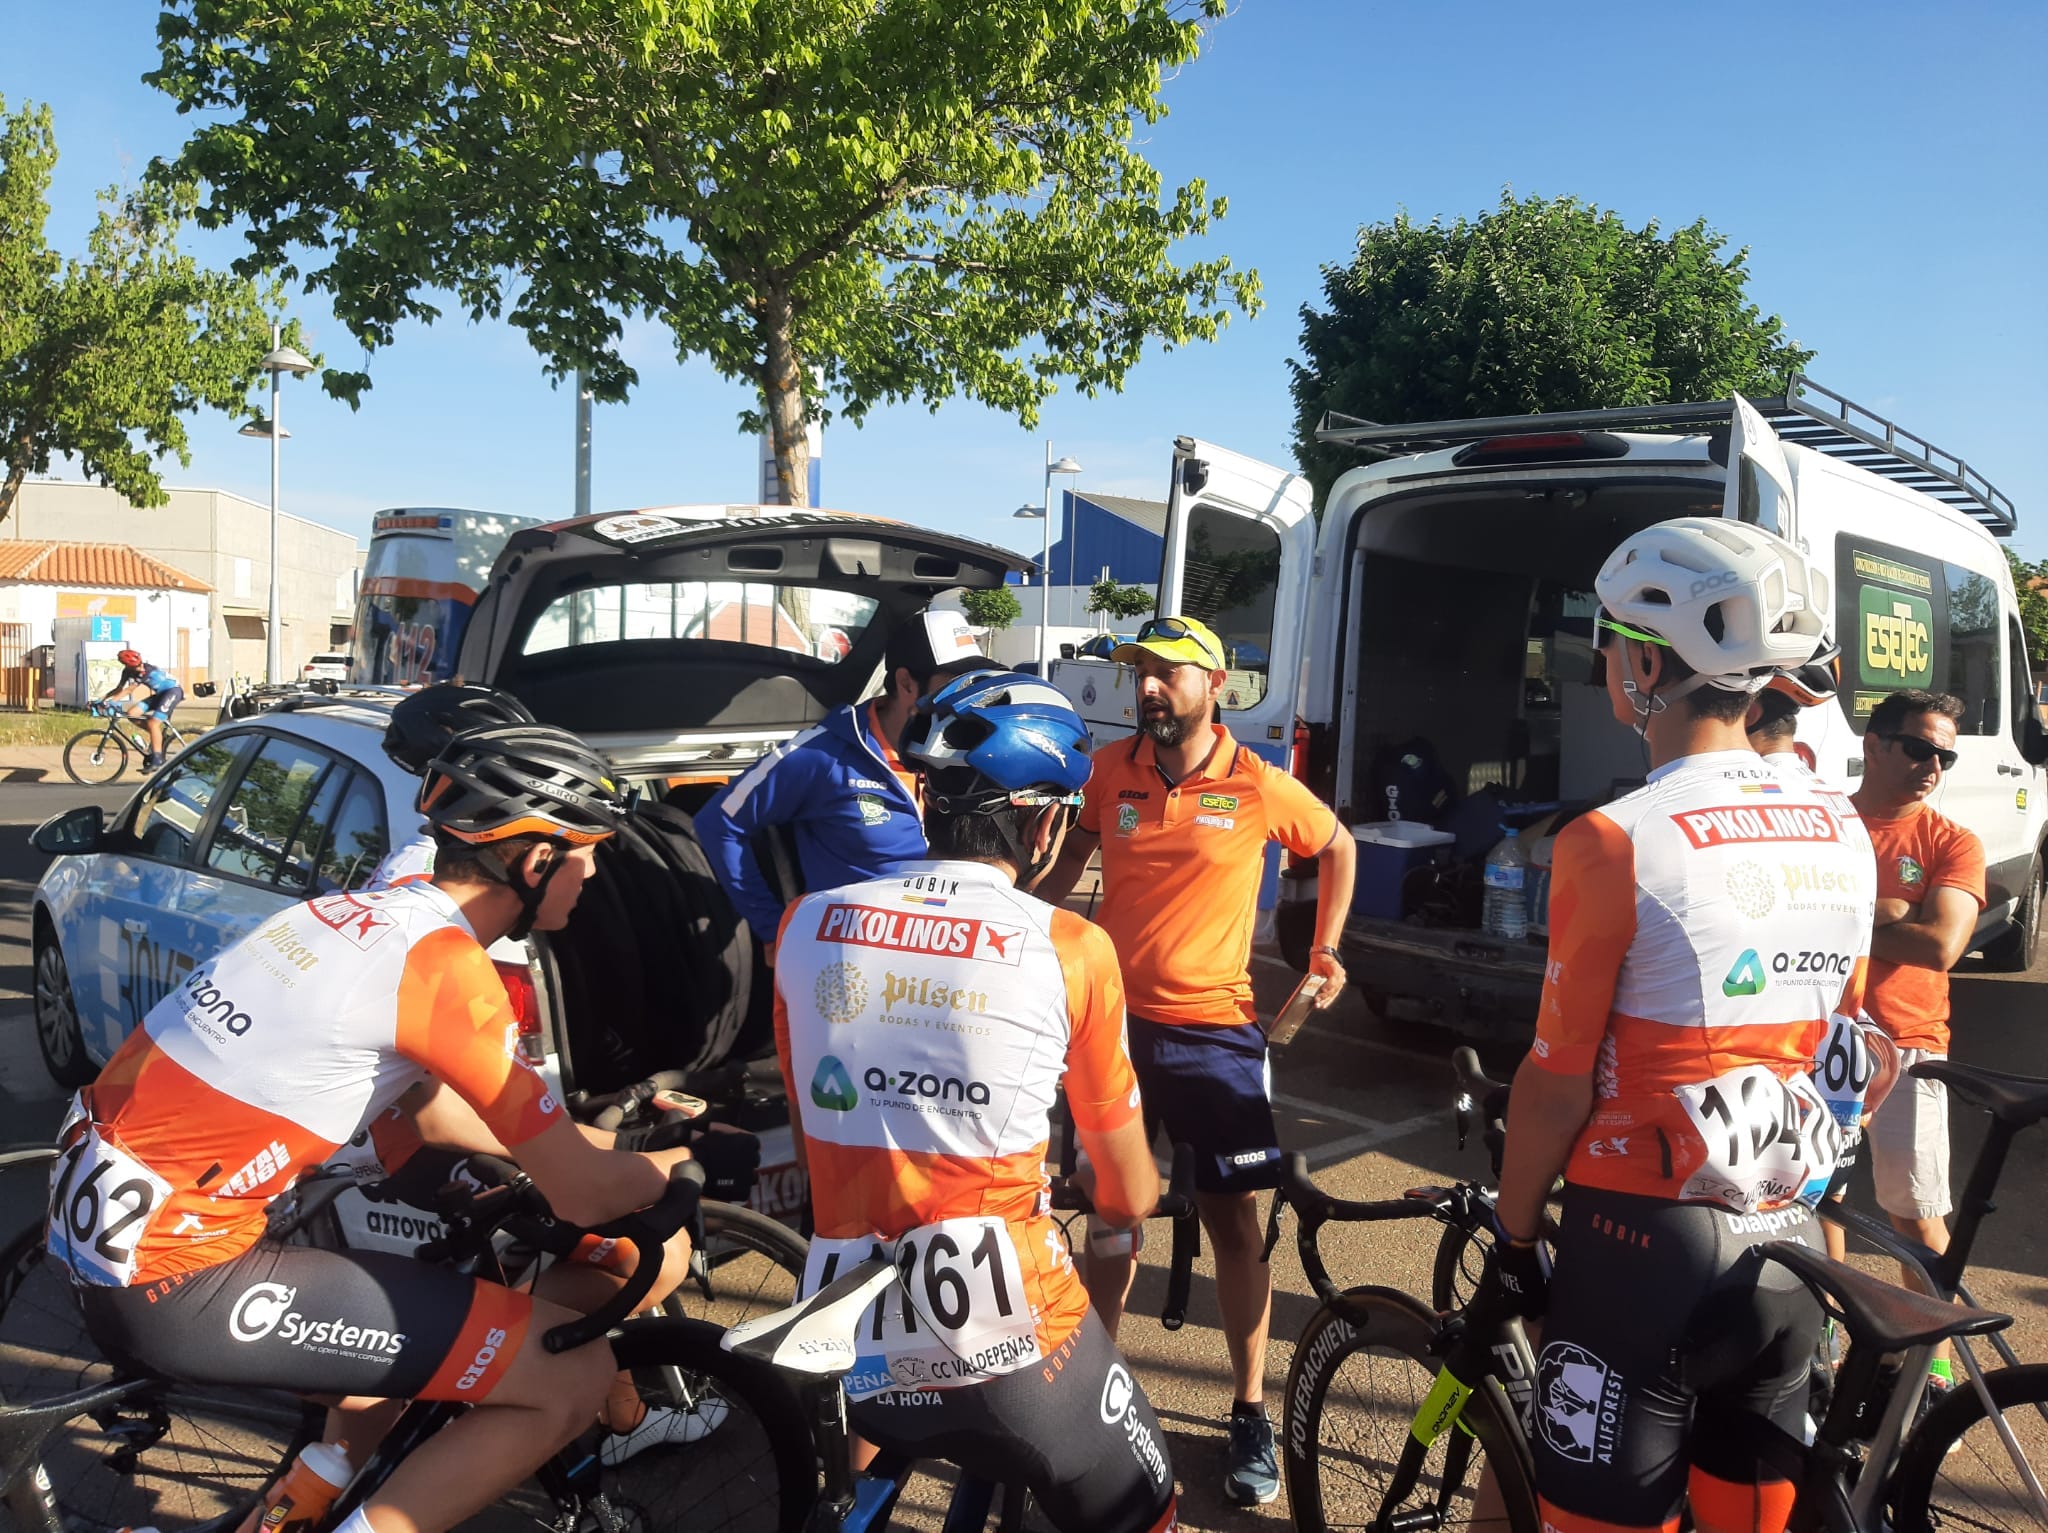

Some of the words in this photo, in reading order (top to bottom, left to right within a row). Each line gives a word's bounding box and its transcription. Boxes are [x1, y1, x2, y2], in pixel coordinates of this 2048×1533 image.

[1866, 601, 1928, 678] ESETEC
[545, 784, 579, 804] GIRO
[1684, 808, 1831, 844] PIKOLINOS
[825, 908, 971, 953] PIKOLINOS
[880, 969, 989, 1014] Pilsen
[879, 1014, 919, 1027] BODAS
[924, 1019, 931, 1028] Y
[935, 1021, 991, 1036] EVENTOS
[870, 1098, 881, 1107] TU
[883, 1100, 911, 1112] PUNTO
[912, 1103, 925, 1114] DE
[926, 1105, 982, 1120] ENCUENTRO
[1233, 1150, 1267, 1165] GIOS
[53, 1140, 155, 1266] 162
[1726, 1205, 1808, 1237] Dialprix
[902, 1226, 1014, 1334] 161
[278, 1311, 407, 1356] Systems
[317, 1346, 338, 1358] open
[358, 1352, 396, 1366] company
[456, 1327, 506, 1391] GIOS
[931, 1361, 952, 1380] CC
[951, 1334, 1035, 1378] VALDEPEÑAS
[877, 1392, 896, 1406] LA
[900, 1392, 943, 1407] HOYA
[1597, 1369, 1624, 1465] ALIFOREST
[1124, 1404, 1167, 1485] Systems
